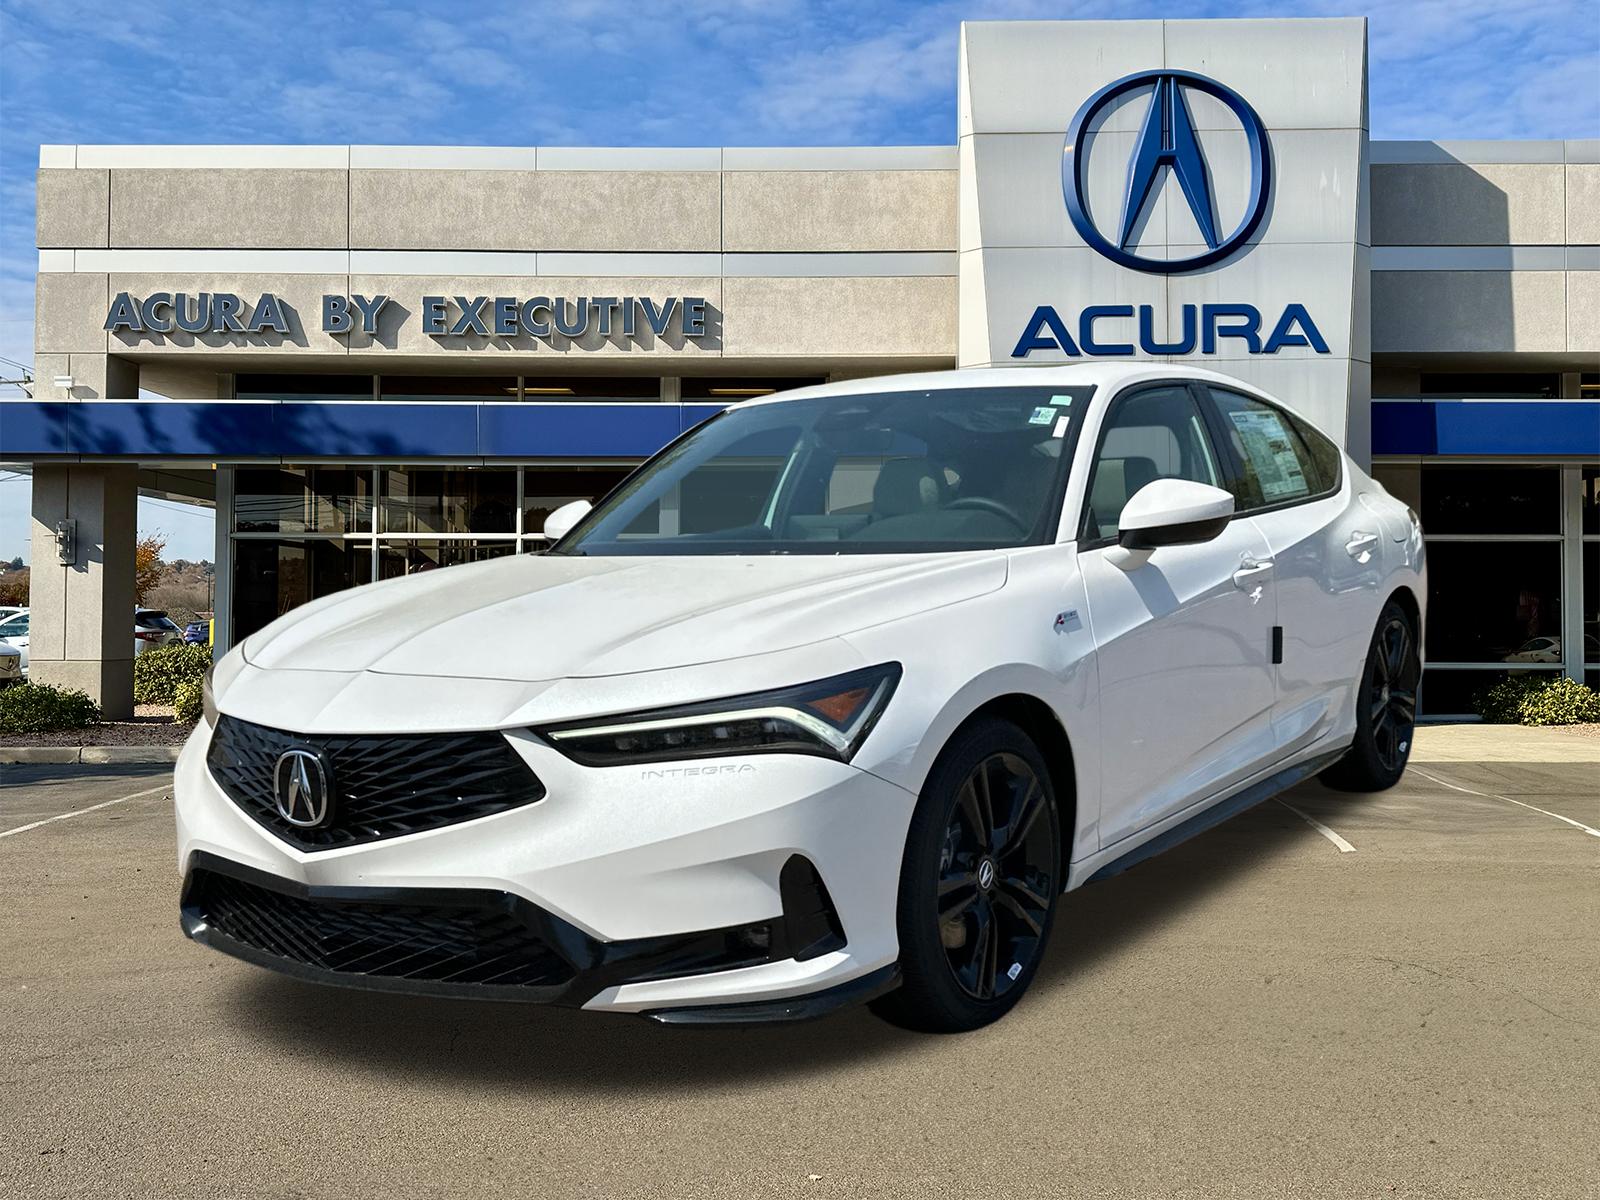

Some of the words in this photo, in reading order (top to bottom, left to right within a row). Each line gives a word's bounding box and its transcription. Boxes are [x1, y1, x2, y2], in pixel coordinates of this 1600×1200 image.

[104, 292, 290, 333] ACURA
[322, 293, 391, 333] BY
[422, 296, 706, 335] EXECUTIVE
[1011, 303, 1332, 357] ACURA
[641, 764, 756, 780] INTEGRA
